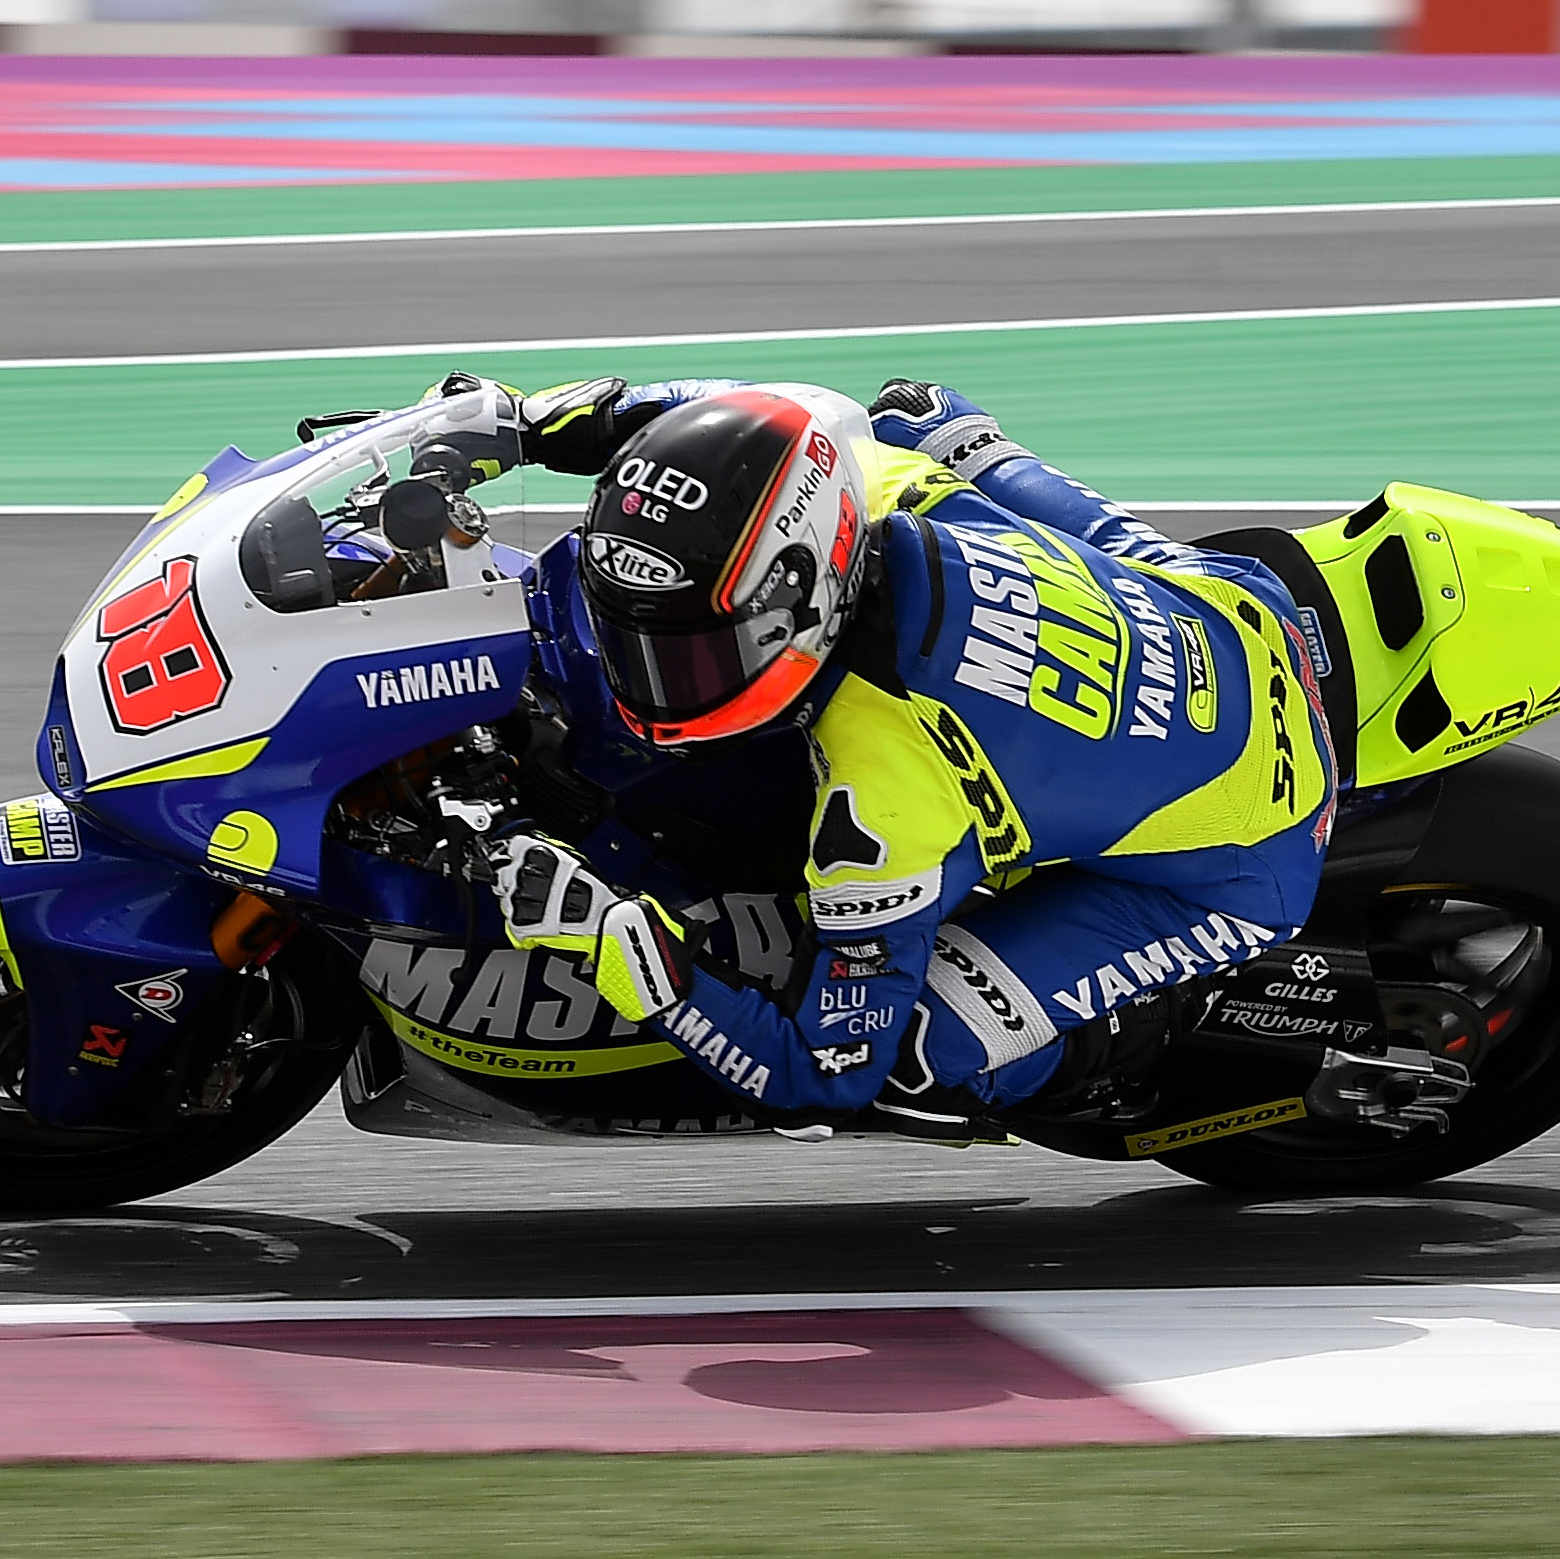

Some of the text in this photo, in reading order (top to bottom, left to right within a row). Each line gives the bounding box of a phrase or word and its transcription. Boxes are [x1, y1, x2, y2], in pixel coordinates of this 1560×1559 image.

[616, 457, 709, 511] OLED
[640, 499, 670, 523] LG
[596, 538, 669, 584] X-lite
[97, 554, 234, 736] 18
[1112, 578, 1176, 740] YAMAHA
[356, 655, 501, 708] YAMAHA
[49, 728, 71, 785] KALEX
[918, 708, 1028, 873] SPI
[43, 799, 76, 856] STER
[359, 893, 797, 1041] MASR
[1052, 912, 1277, 1021] YAMAHA
[1265, 982, 1338, 1003] GILLES
[1221, 1008, 1339, 1036] TRIUMPH
[1225, 1000, 1288, 1013] POWERED BY
[408, 1026, 576, 1073] #theTeam
[659, 1000, 771, 1099] AMAHA
[1165, 1104, 1298, 1144] DUNLOP
